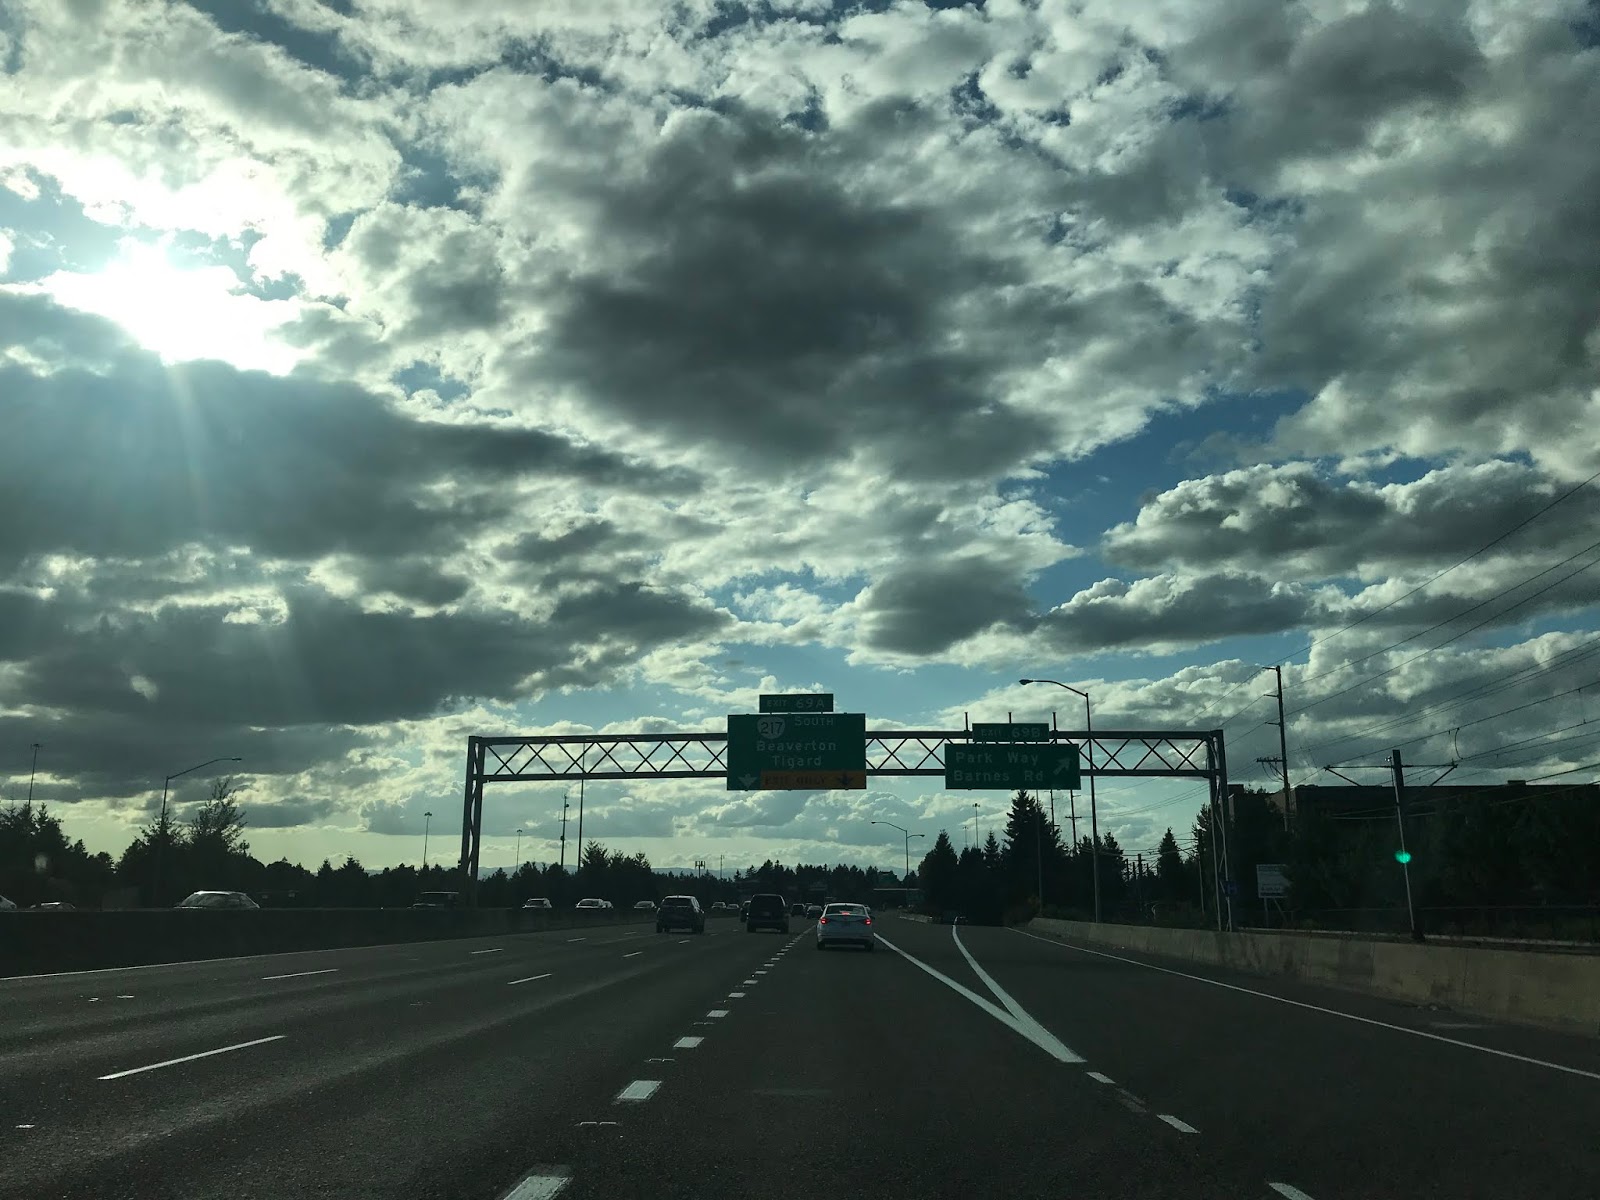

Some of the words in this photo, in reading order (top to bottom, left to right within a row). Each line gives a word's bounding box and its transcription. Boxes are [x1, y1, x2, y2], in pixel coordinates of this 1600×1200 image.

[796, 698, 825, 708] 69A
[760, 721, 783, 735] 217
[756, 740, 837, 751] Beaverton
[772, 755, 822, 769] Tigard
[955, 751, 993, 763] Park
[1007, 751, 1039, 766] Way
[953, 770, 1010, 782] Barnes
[1024, 770, 1044, 782] Rd
